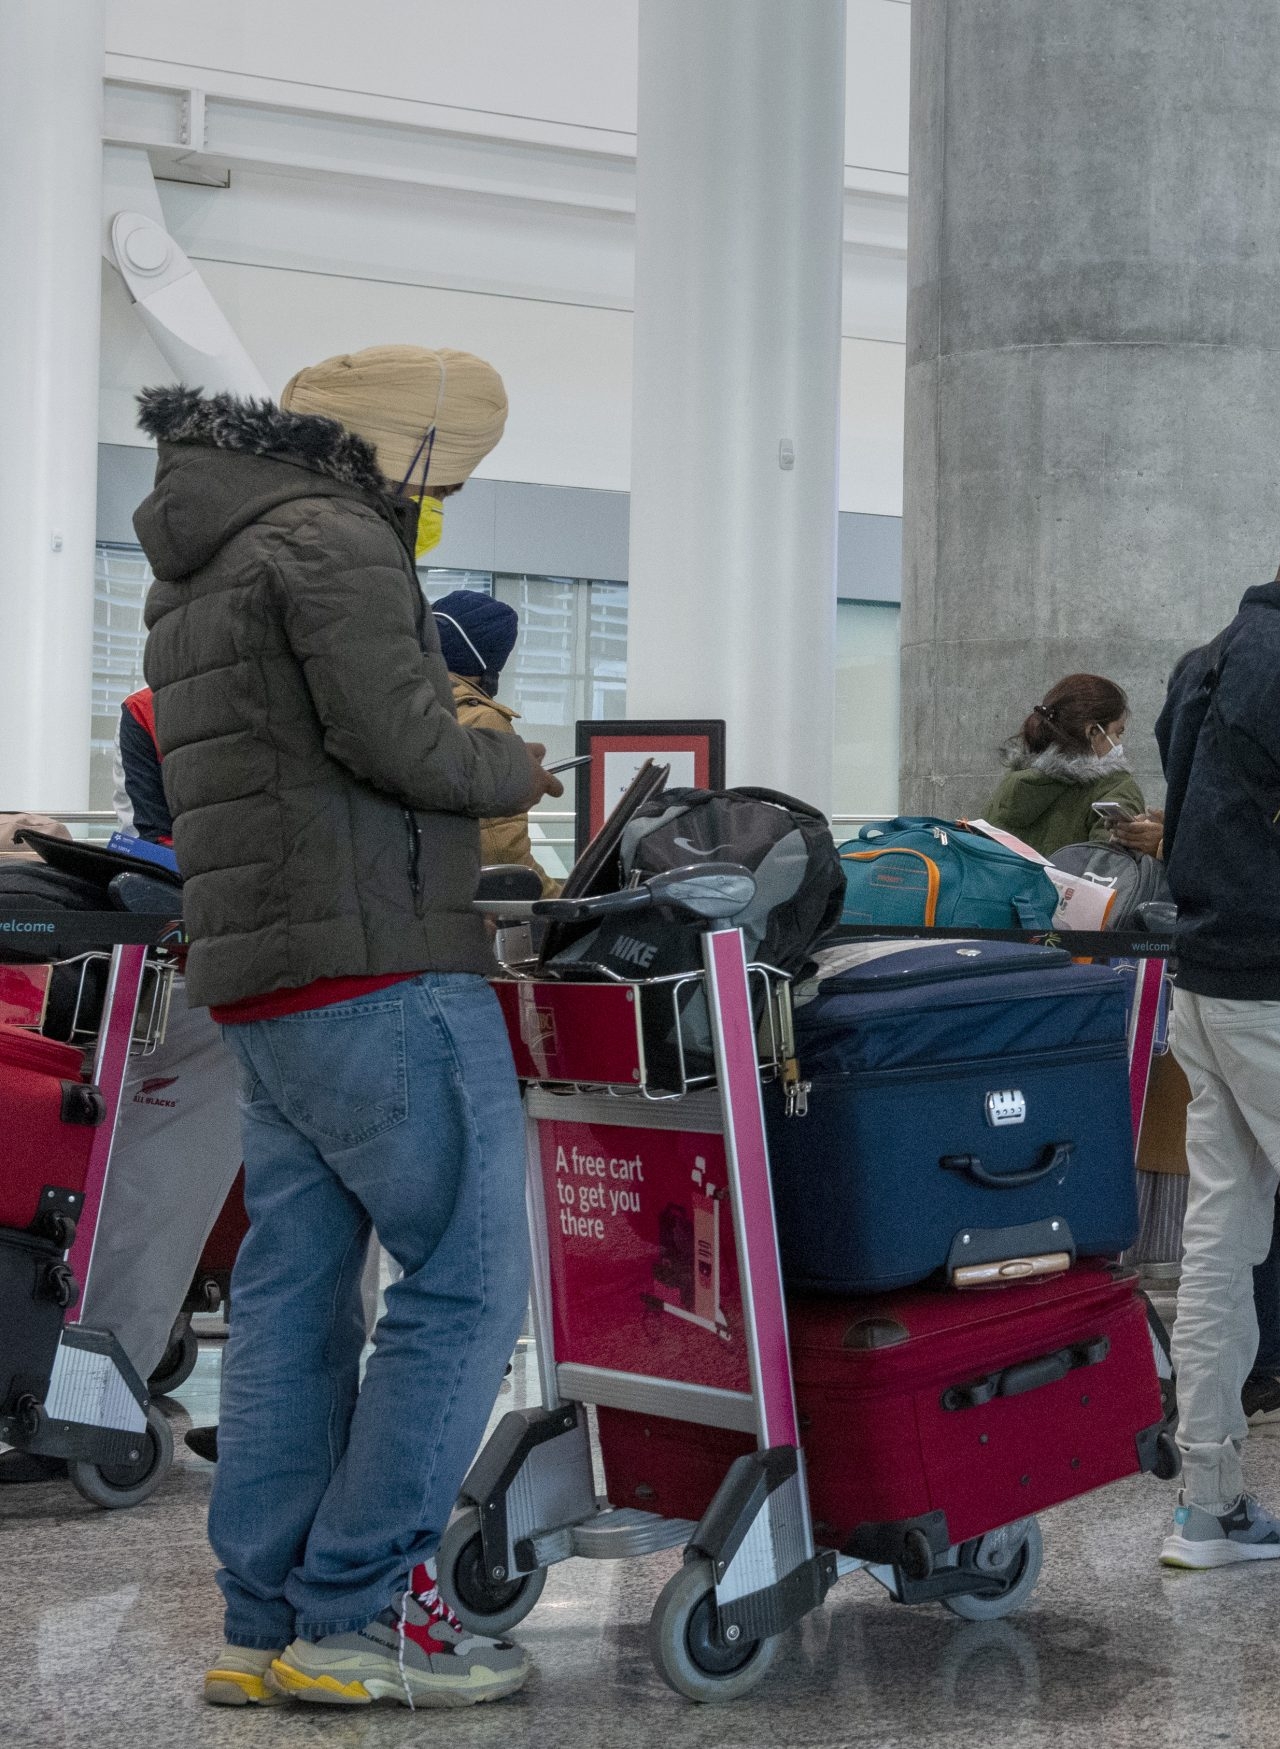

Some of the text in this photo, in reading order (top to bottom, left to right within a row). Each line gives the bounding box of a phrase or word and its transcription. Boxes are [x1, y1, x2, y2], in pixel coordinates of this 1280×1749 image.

[609, 935, 658, 968] NIKE
[145, 1098, 176, 1107] BLACKS
[556, 1146, 644, 1182] A free cart
[557, 1178, 640, 1216] to get you
[560, 1207, 605, 1239] there
